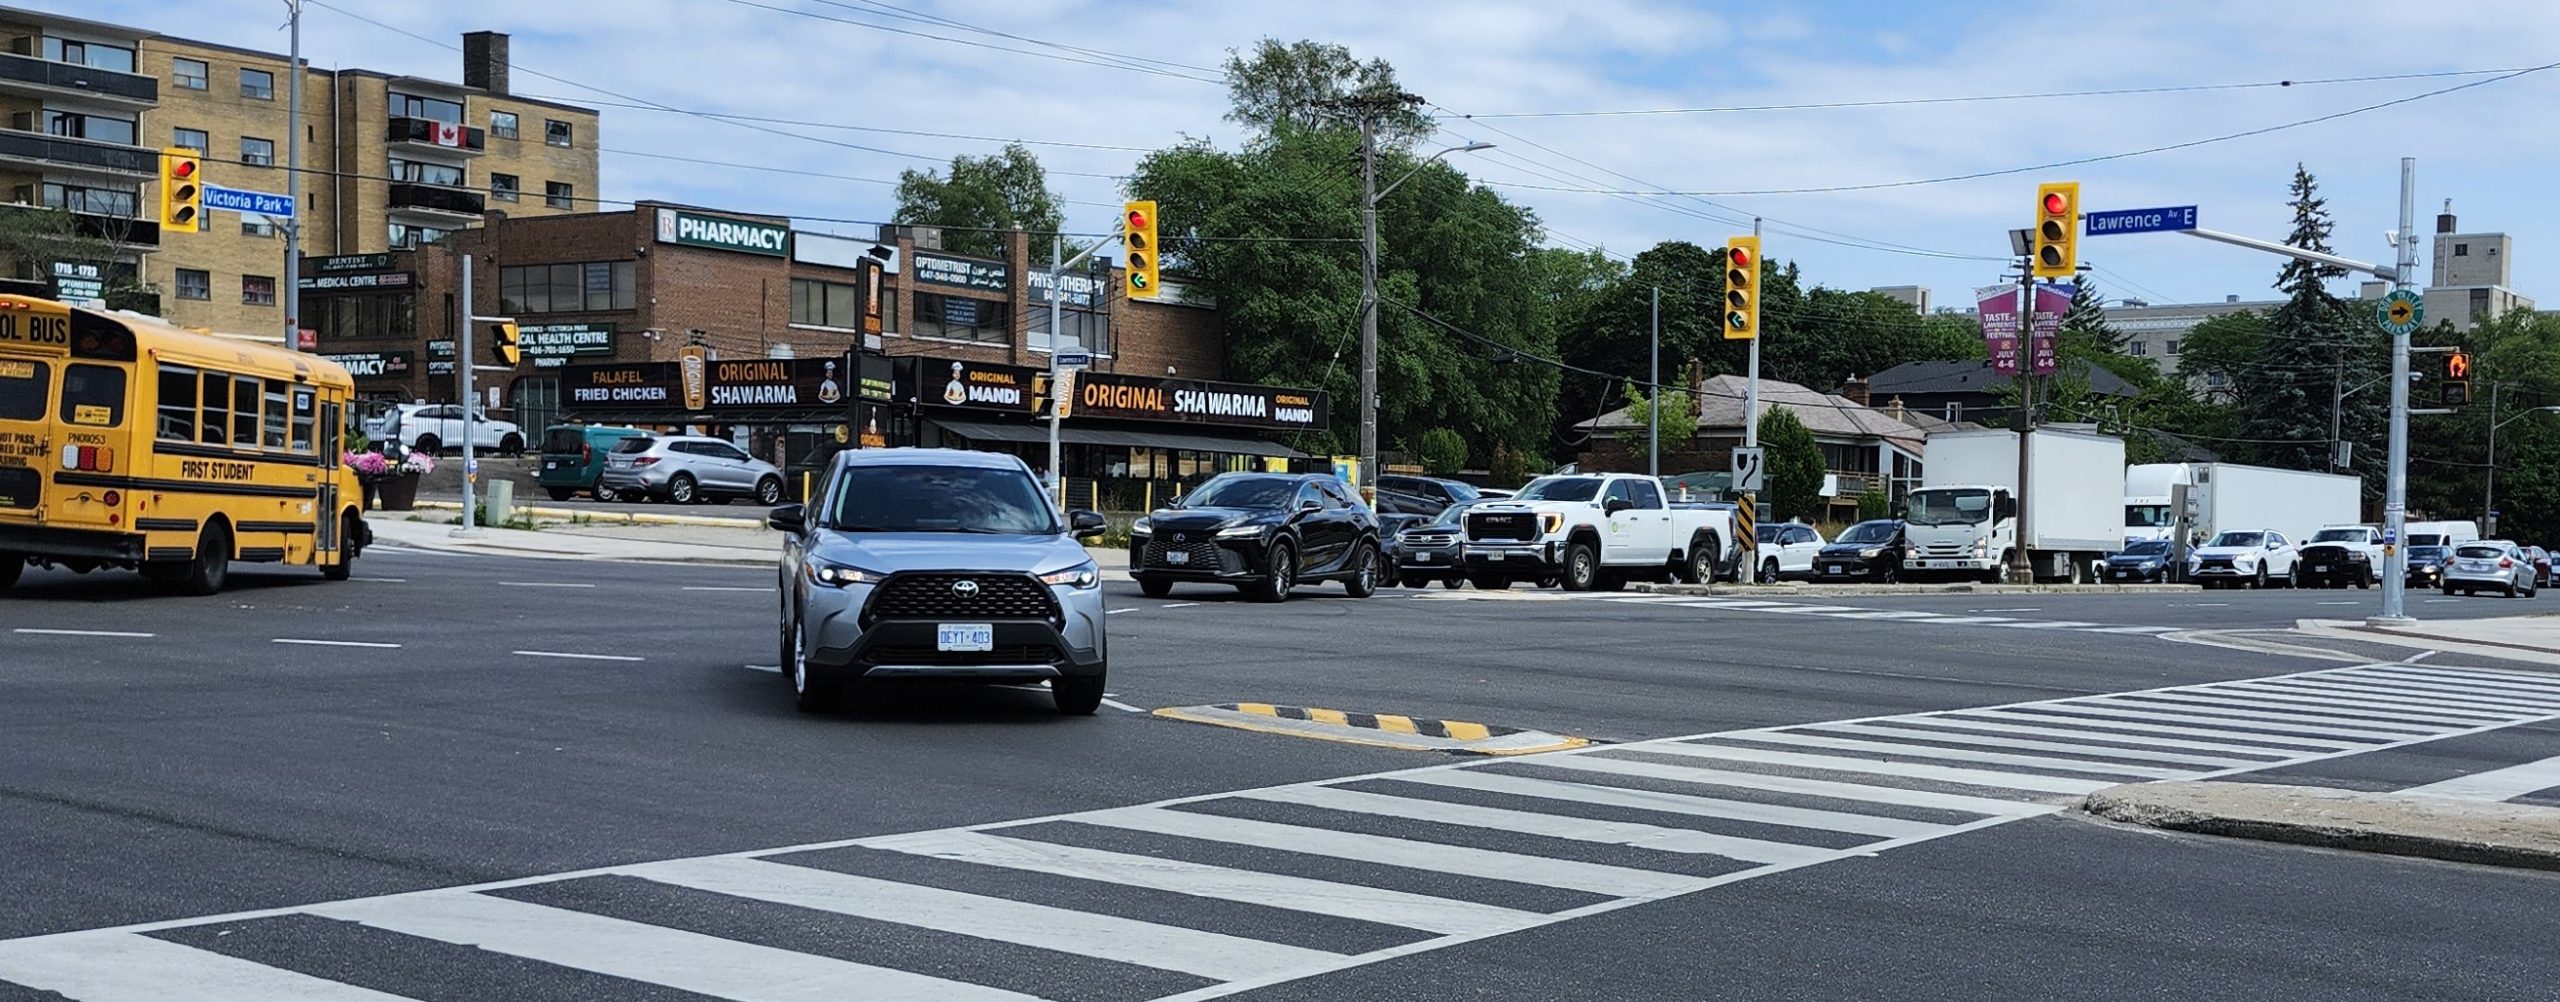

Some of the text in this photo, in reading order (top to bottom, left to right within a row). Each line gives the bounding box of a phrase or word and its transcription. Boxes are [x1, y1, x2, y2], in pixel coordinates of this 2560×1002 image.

[205, 189, 252, 209] Victoria
[255, 196, 283, 212] Park
[2090, 208, 2193, 231] Lawrence Av E
[679, 217, 787, 251] PHARMACY
[328, 256, 368, 266] DENTIST
[915, 256, 972, 275] OPTOMETRIST
[316, 275, 348, 288] MEDICAL
[349, 275, 377, 287] CENTRE
[1027, 270, 1106, 296] PHYSTHERAPY
[1983, 312, 2011, 322] TASTE
[2035, 311, 2054, 321] TASTE
[0, 313, 67, 343] OL BUS
[537, 333, 571, 345] HEALTH
[572, 331, 609, 344] CENTRE
[1996, 350, 2016, 359] JULY
[342, 359, 387, 376] MACY
[1998, 359, 2015, 368] 4-6
[2038, 358, 2055, 367] 4-6
[592, 370, 644, 384] FALAFEL
[719, 362, 789, 381] ORIGINAL
[969, 371, 1016, 385] ORIGINAL
[574, 387, 667, 402] FRIED CHICKEN
[711, 385, 798, 404] SHAWARMA
[968, 385, 1021, 405] MANDI
[1083, 383, 1166, 412] ORIGINAL
[1275, 394, 1310, 406] ORIGINAL
[1274, 407, 1314, 423] MANDI
[15, 433, 35, 444] PASS
[182, 461, 255, 480] FIRST STUDENT
